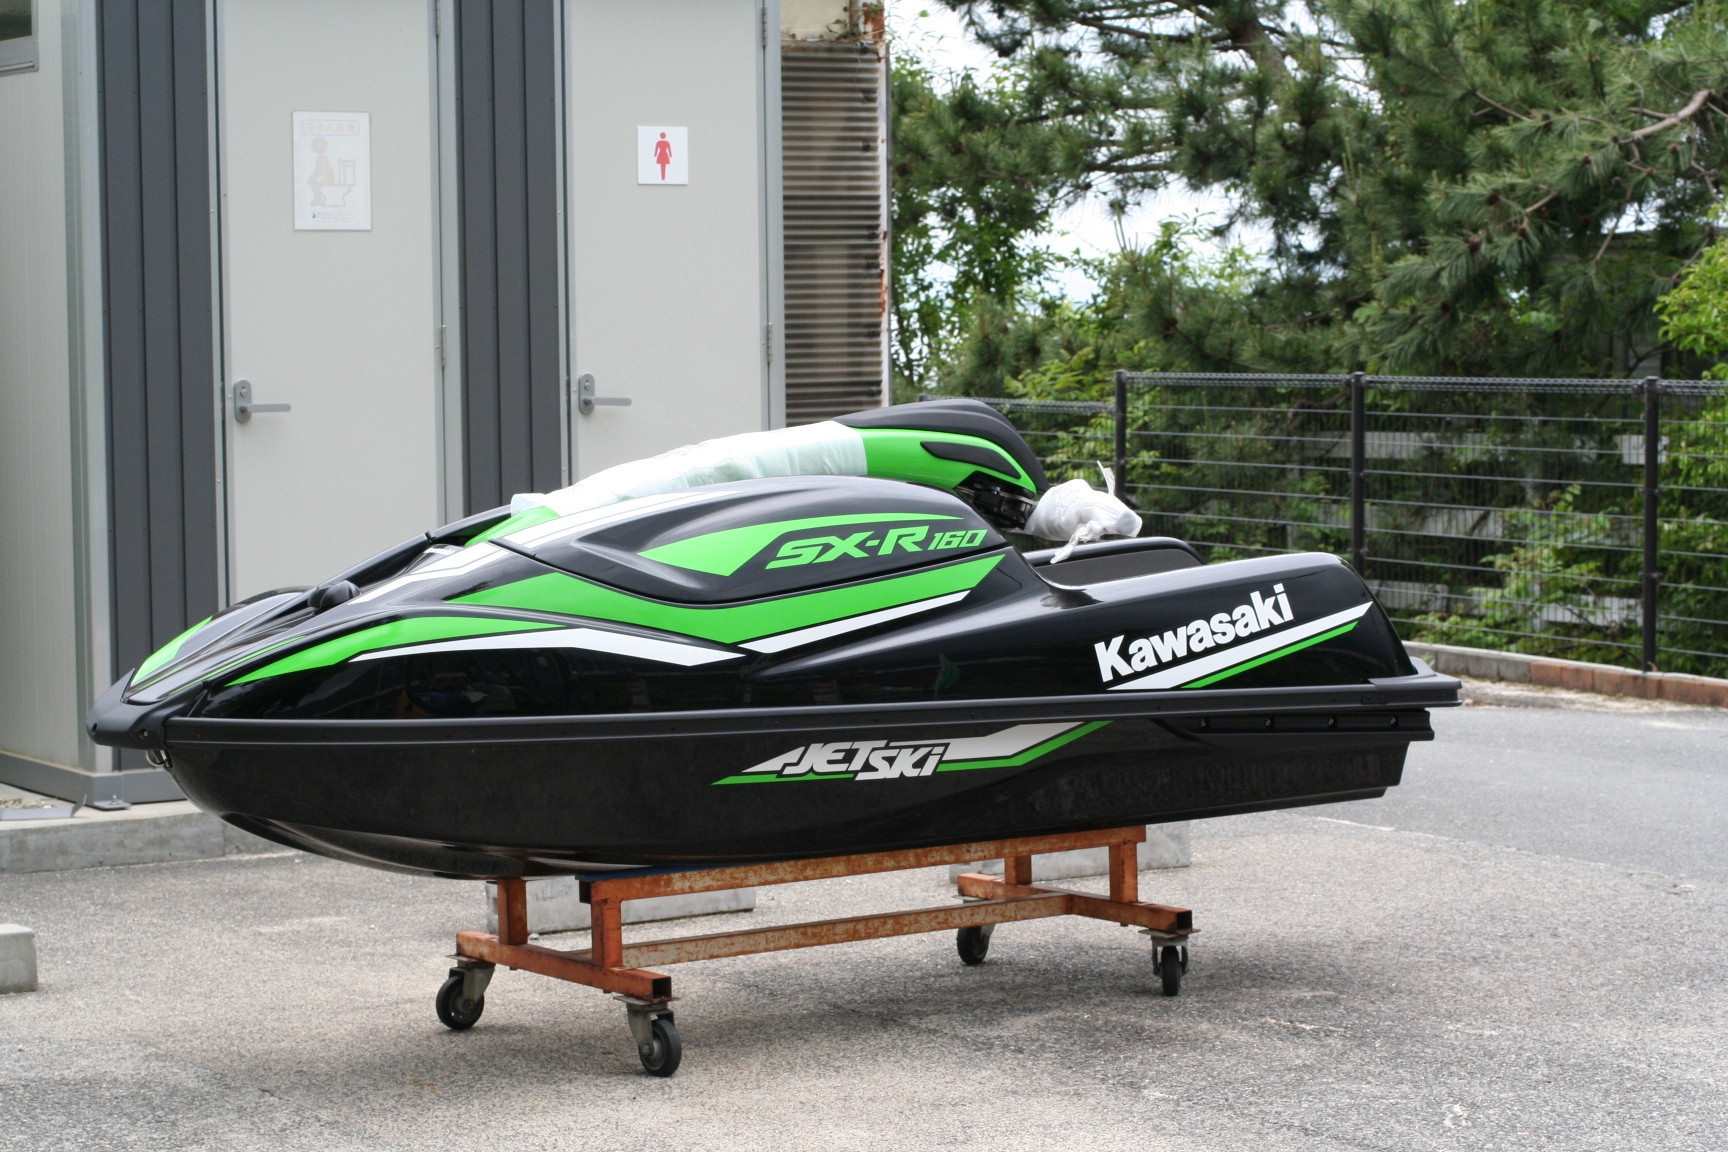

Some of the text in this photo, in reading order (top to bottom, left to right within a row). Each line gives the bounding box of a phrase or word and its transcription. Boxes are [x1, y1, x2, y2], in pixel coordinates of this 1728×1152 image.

[765, 525, 988, 570] SX-R 160
[1094, 582, 1295, 683] Kawasaki
